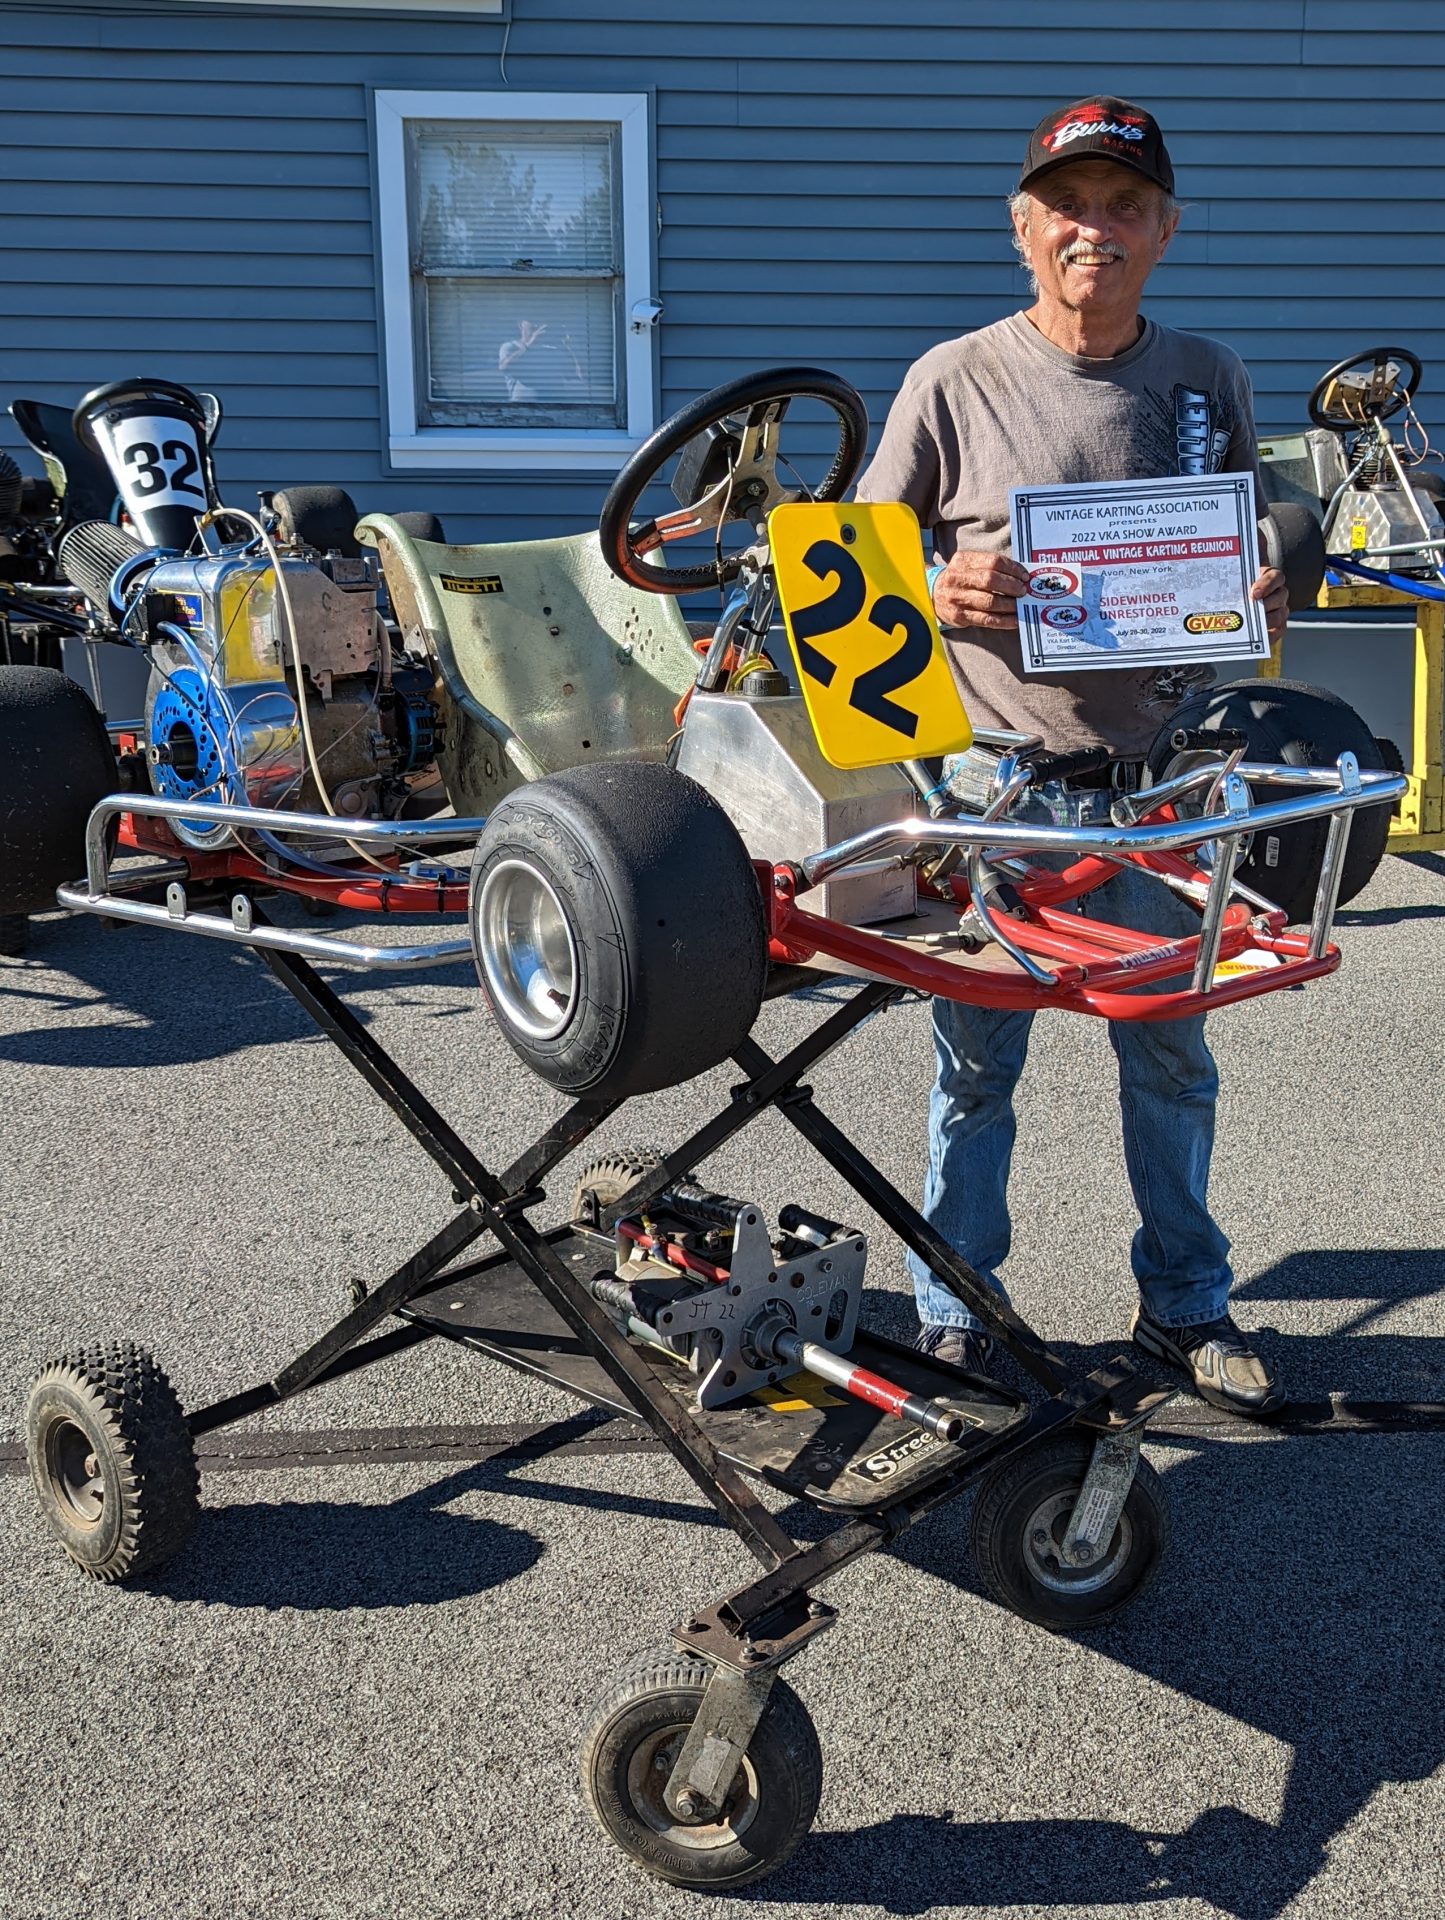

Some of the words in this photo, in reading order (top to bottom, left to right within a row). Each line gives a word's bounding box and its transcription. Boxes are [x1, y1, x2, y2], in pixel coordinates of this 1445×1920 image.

[1053, 121, 1145, 148] Burris
[1103, 137, 1143, 156] RACING
[123, 440, 205, 498] 32
[1045, 508, 1093, 522] VINTAGE
[1096, 504, 1144, 519] KARTING
[1146, 500, 1219, 515] ASSOCIATION
[1108, 517, 1157, 528] presents
[1071, 532, 1096, 543] 2022
[1098, 530, 1120, 541] VKA
[1123, 528, 1155, 540] SHOW
[1157, 525, 1197, 537] AWARD
[1061, 549, 1100, 563] ANNUAL
[1103, 546, 1143, 560] VINTAGE
[1146, 543, 1187, 557] KARTING
[1190, 540, 1233, 553] REUNION
[442, 578, 500, 593] TILLETT
[1099, 592, 1177, 607] SIDEWINDER
[1099, 606, 1179, 620] UNRESTORED
[1188, 615, 1231, 631] GVKC
[789, 539, 933, 739] 22
[1117, 944, 1180, 969] PHOENIX
[689, 1300, 712, 1319] JT
[719, 1304, 736, 1319] 22
[866, 1431, 934, 1480] Stree
